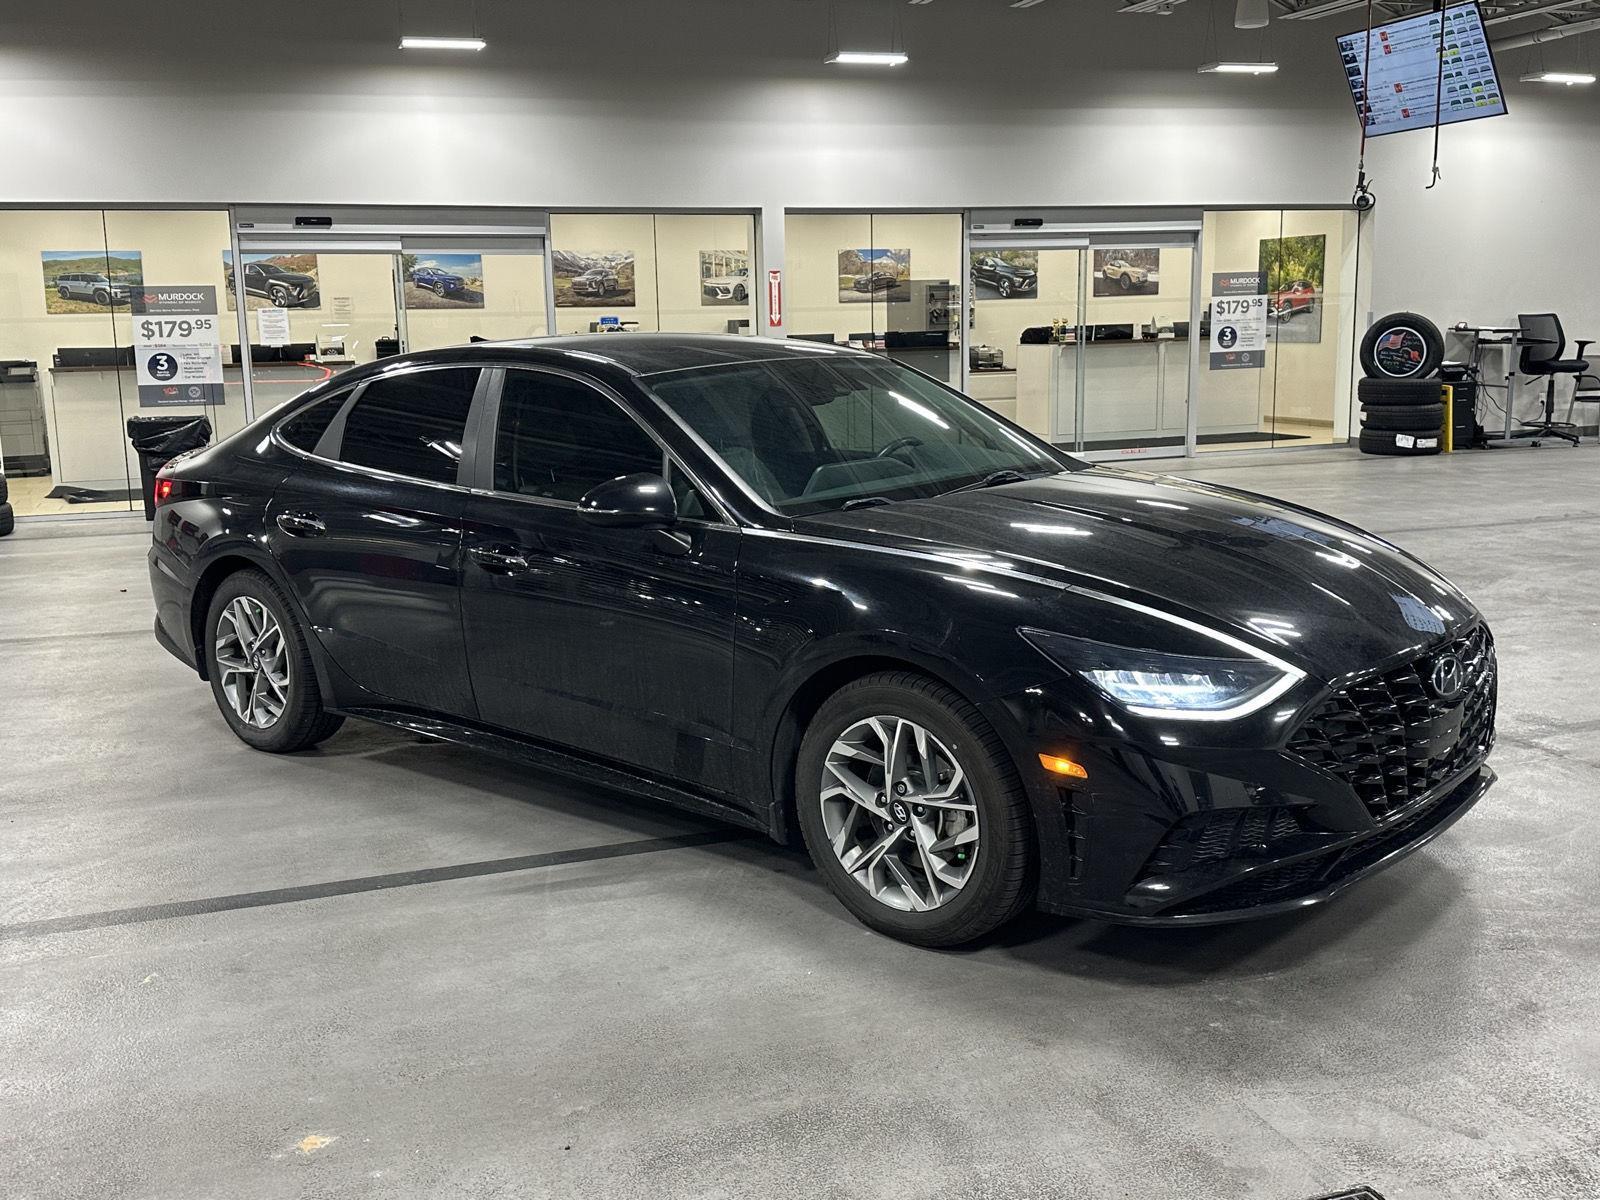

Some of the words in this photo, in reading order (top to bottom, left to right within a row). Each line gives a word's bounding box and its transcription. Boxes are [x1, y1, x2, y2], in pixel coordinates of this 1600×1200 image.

[158, 292, 205, 300] MURDOCK
[141, 319, 212, 341] $179.95
[1223, 328, 1231, 340] 3
[156, 355, 169, 371] 3
